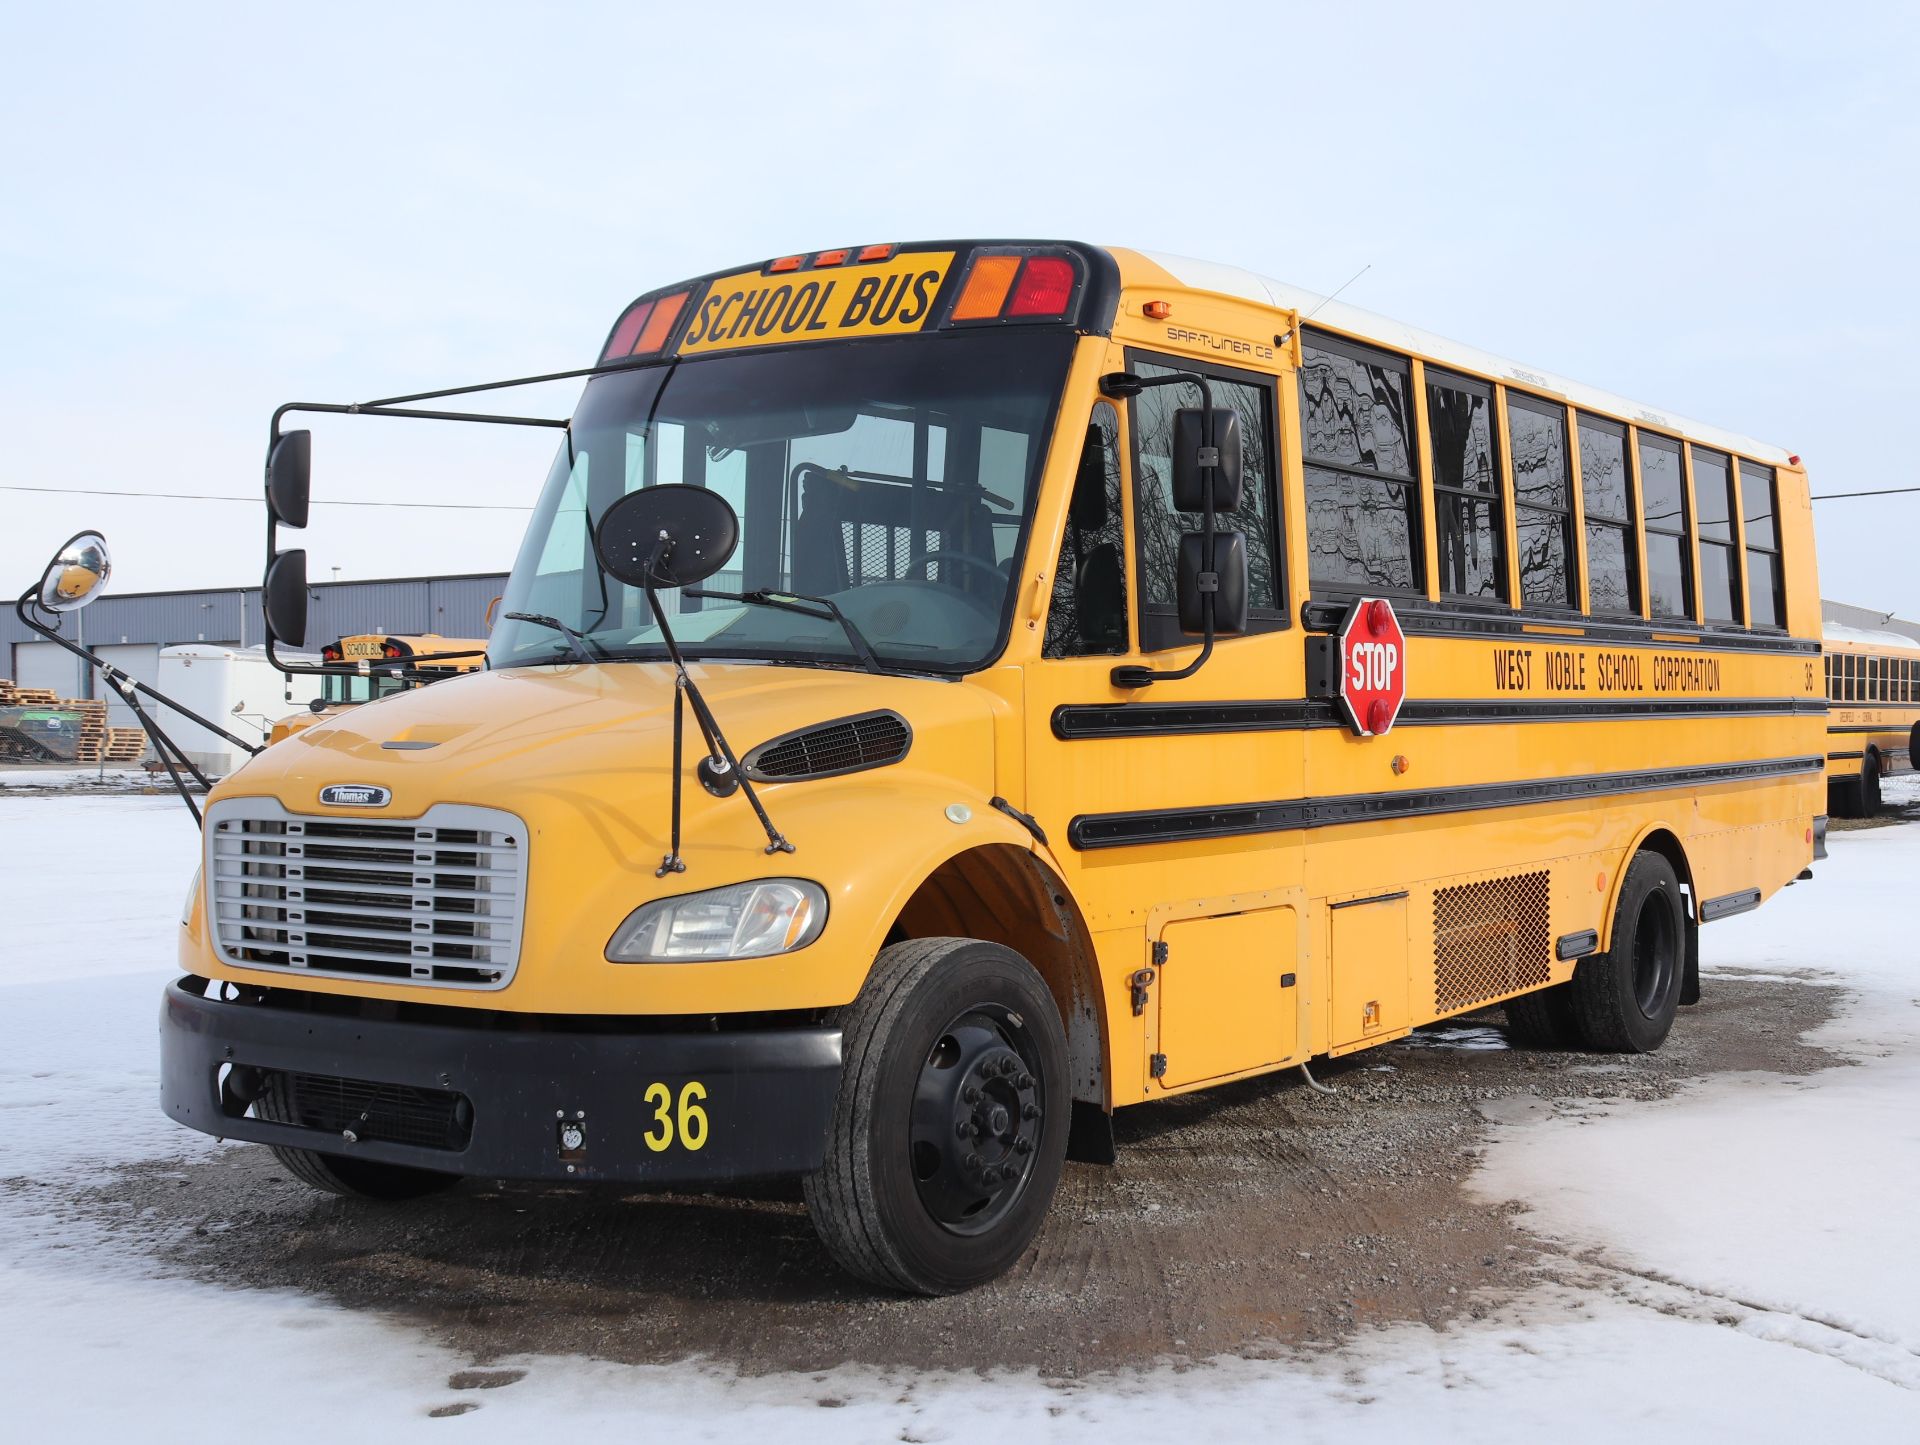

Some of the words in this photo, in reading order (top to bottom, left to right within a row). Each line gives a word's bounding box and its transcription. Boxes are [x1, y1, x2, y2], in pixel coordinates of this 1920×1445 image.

[686, 280, 836, 346] SCHOOL
[839, 269, 940, 328] BUS
[1255, 345, 1273, 360] C2
[347, 643, 369, 656] SCHOOL
[370, 643, 383, 655] BUS
[1351, 642, 1398, 691] STOP
[1493, 648, 1532, 691] WEST
[1545, 650, 1586, 691] NOBLE
[1597, 652, 1643, 692] SCHOOL
[1653, 655, 1721, 692] CORPORATION
[1804, 662, 1814, 692] 36
[331, 787, 375, 803] Thomas
[643, 1081, 709, 1152] 36
